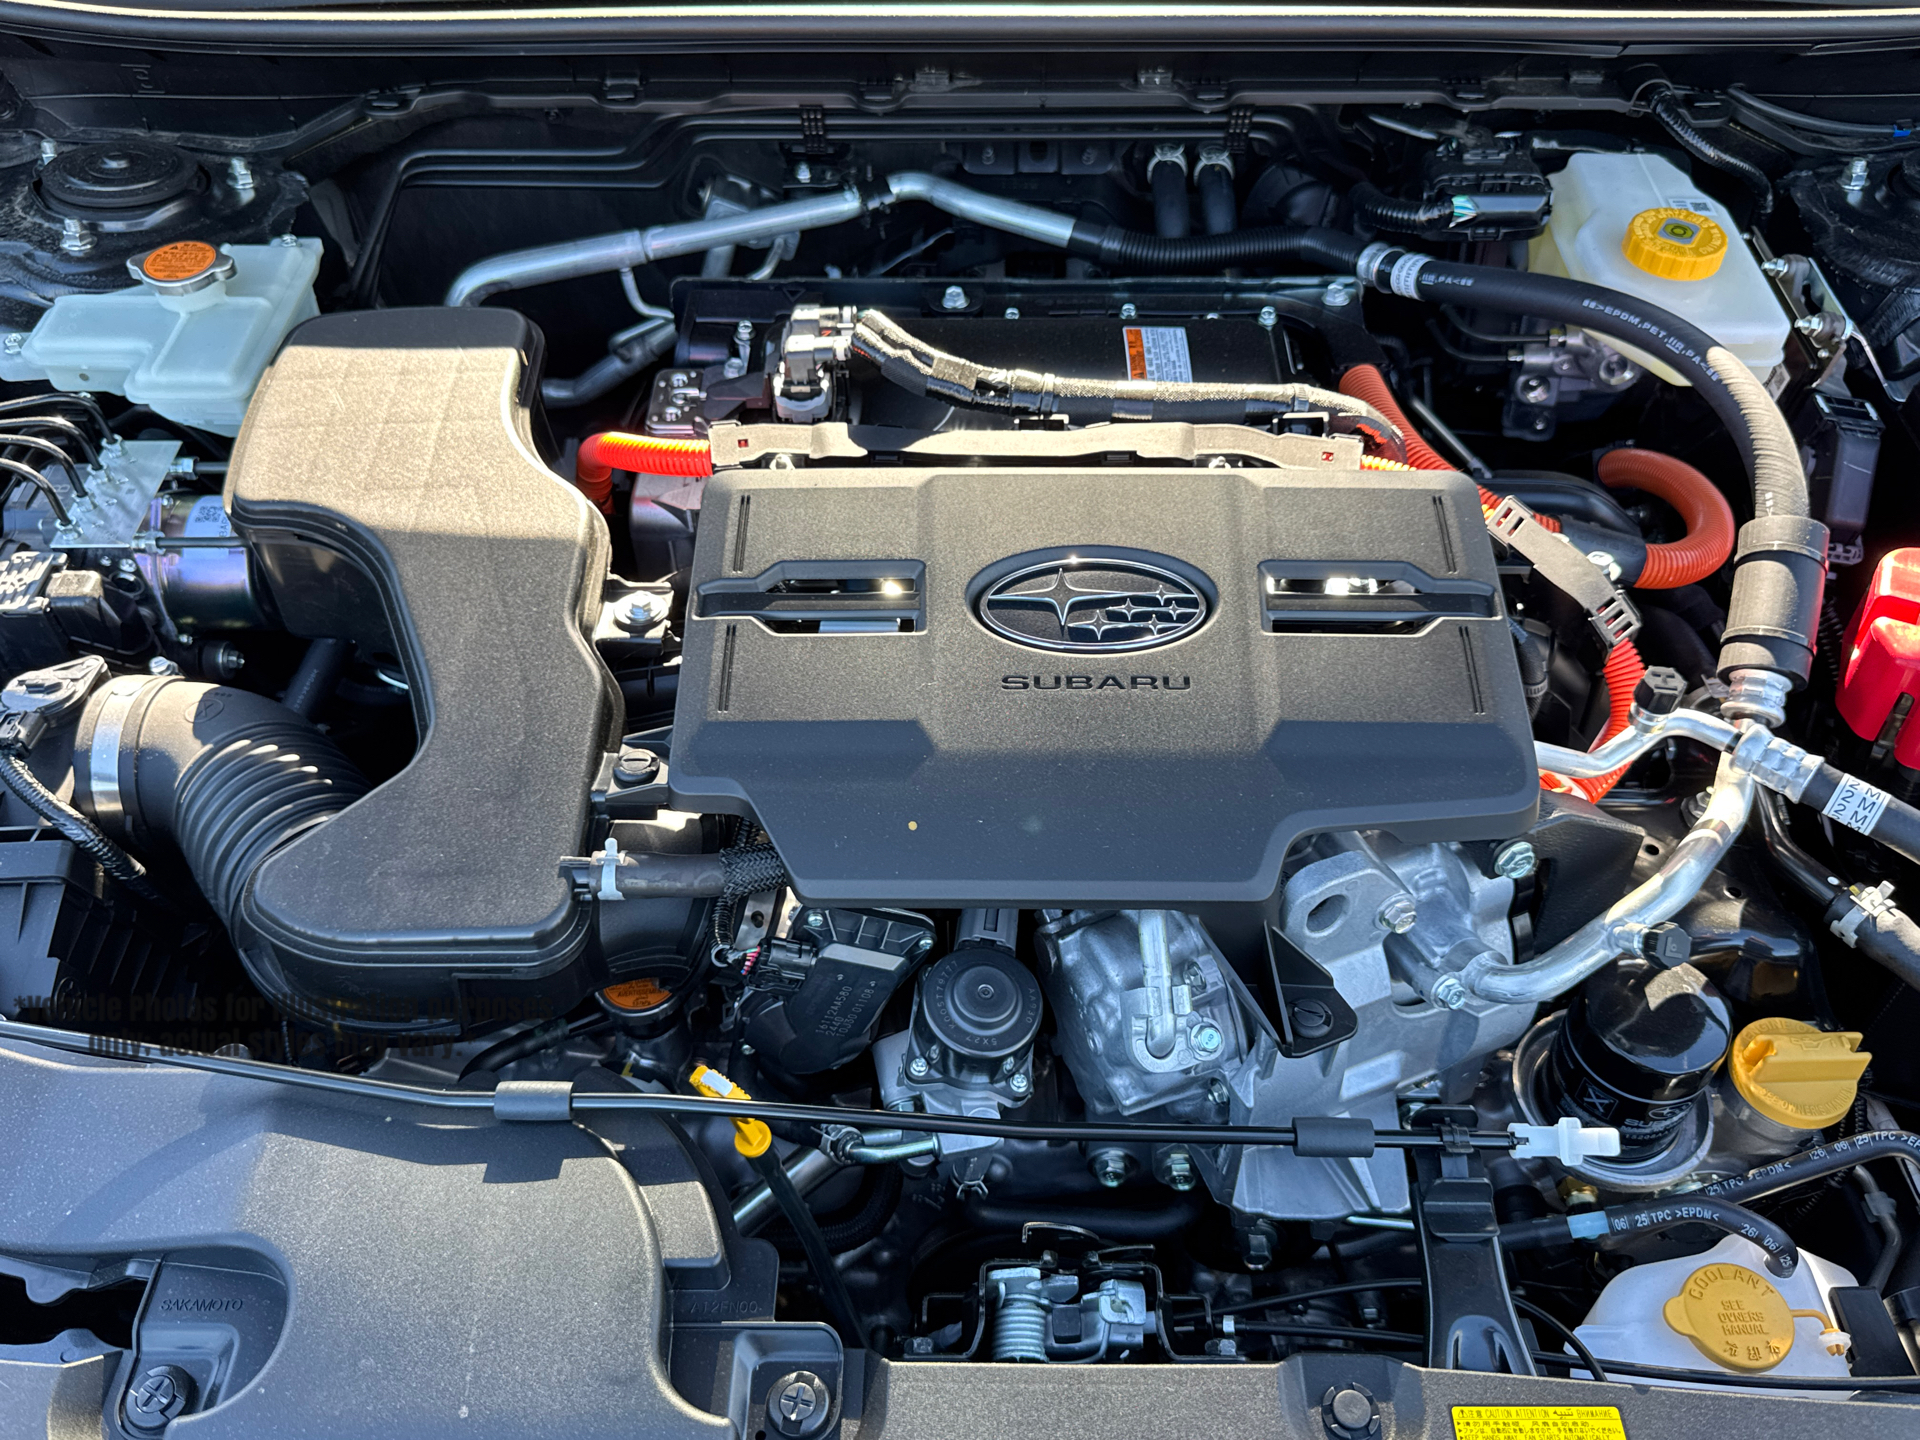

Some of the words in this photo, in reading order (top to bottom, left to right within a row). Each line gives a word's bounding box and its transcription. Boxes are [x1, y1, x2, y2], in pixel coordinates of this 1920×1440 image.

[1001, 675, 1191, 690] SUBARU
[1744, 1019, 1790, 1040] ENGINE
[1873, 1131, 1896, 1141] TPC
[1723, 1176, 1744, 1190] TPC
[1651, 1209, 1672, 1224] TPC
[1688, 1266, 1775, 1300] COOLANT
[161, 1298, 243, 1311] SAKAMOTO
[1721, 1300, 1745, 1311] SEE
[1722, 1323, 1769, 1336] MANUAL
[1485, 1409, 1513, 1419] CAUTION
[1515, 1409, 1550, 1418] ATTENTION
[1576, 1409, 1613, 1418] ВНИМАНИЕ
